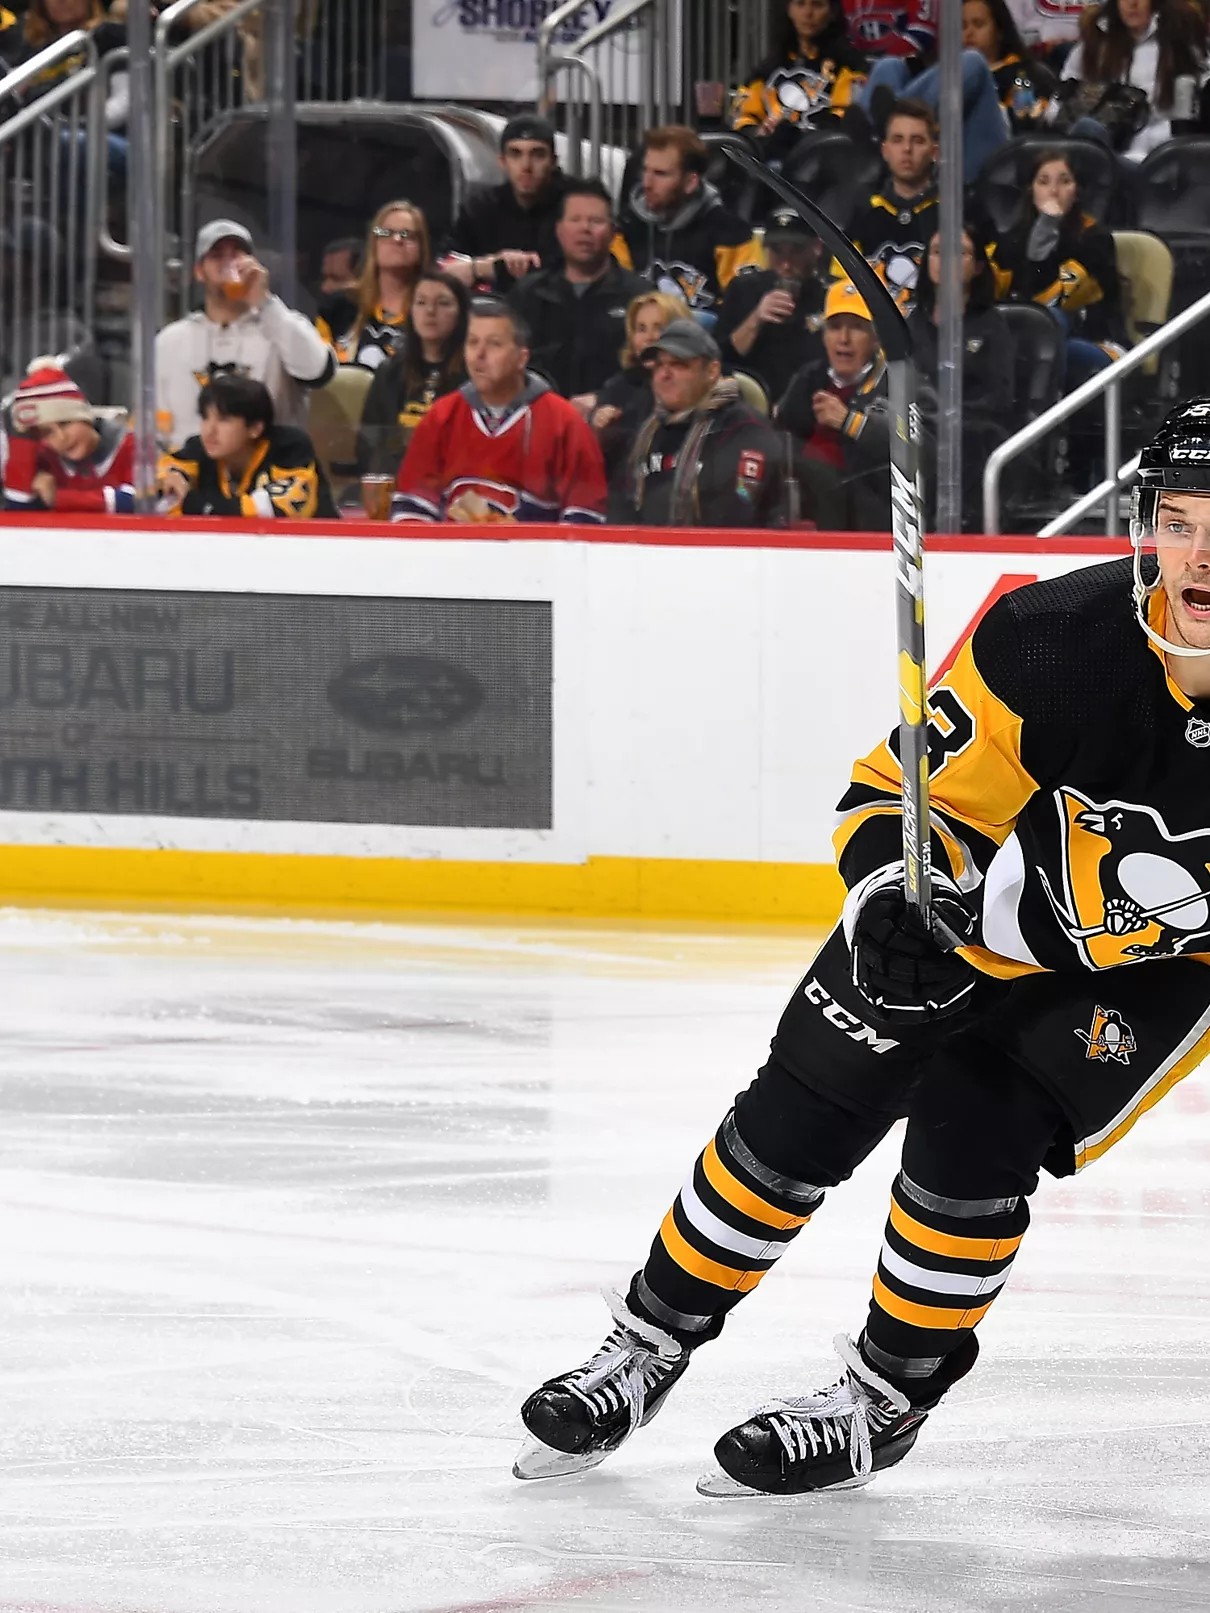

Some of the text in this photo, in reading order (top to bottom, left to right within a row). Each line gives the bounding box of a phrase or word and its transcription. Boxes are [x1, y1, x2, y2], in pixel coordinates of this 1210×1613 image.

[459, 0, 612, 30] SHOREY
[106, 759, 261, 815] HILLS
[306, 748, 507, 788] SUBARU
[922, 840, 932, 877] CCM
[804, 976, 901, 1054] CCM
